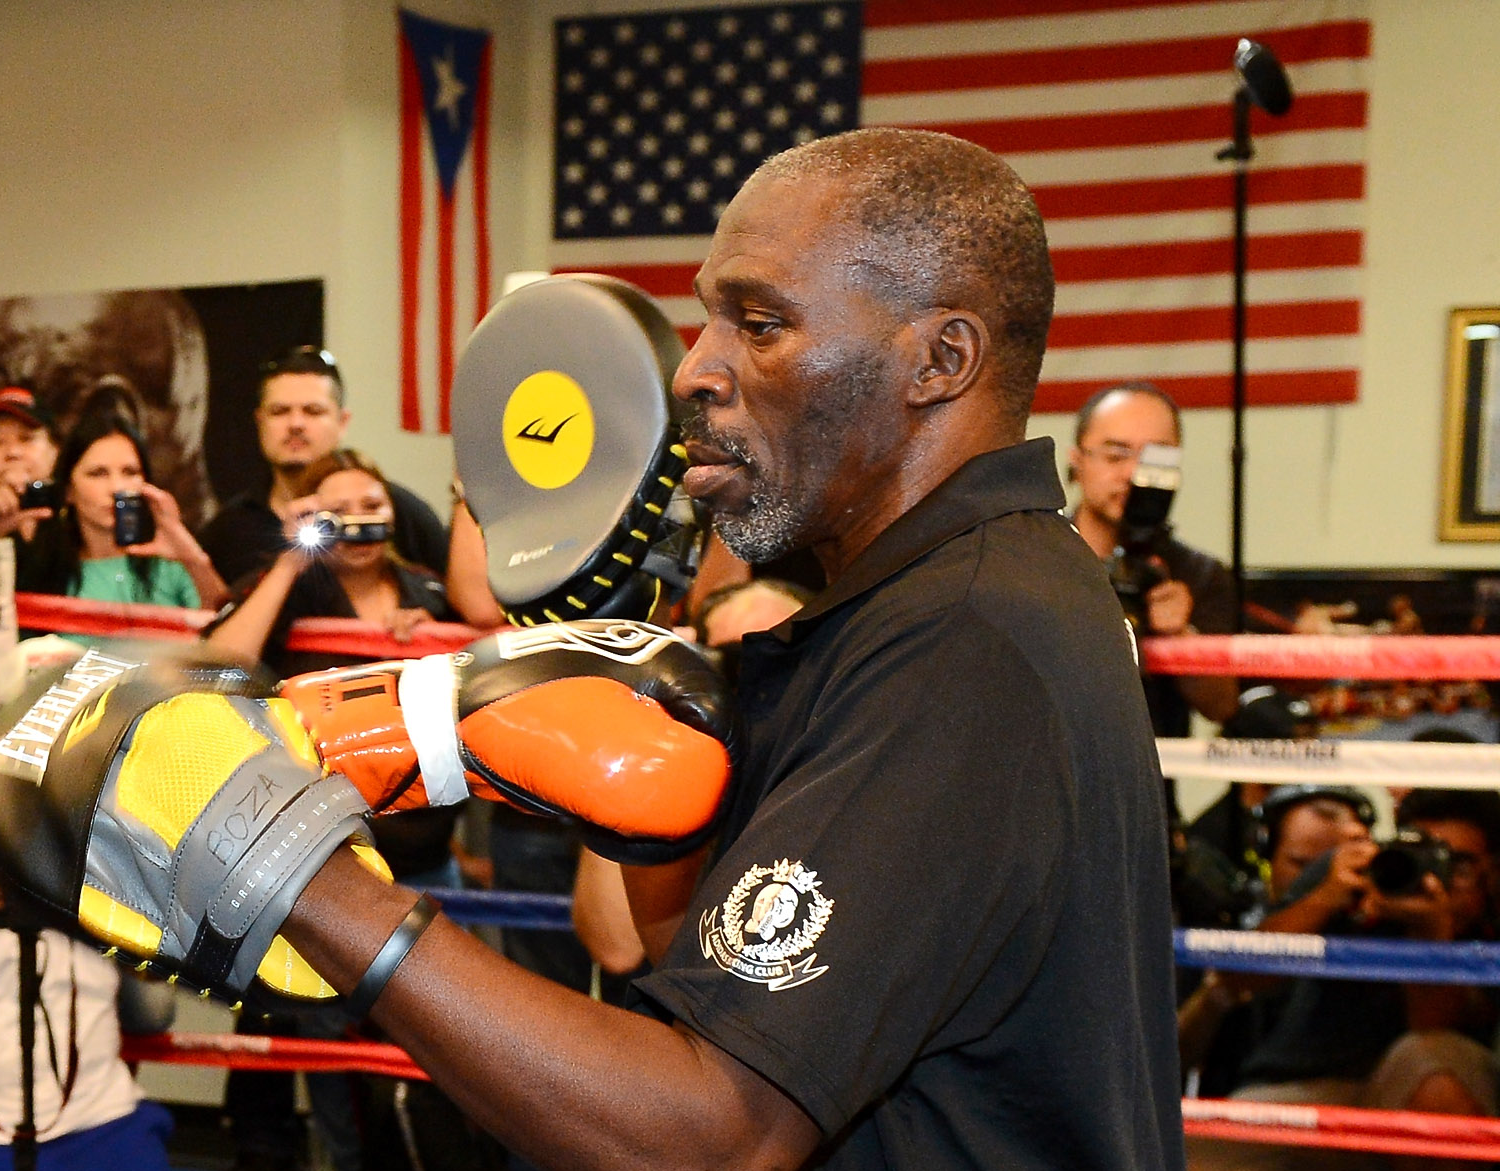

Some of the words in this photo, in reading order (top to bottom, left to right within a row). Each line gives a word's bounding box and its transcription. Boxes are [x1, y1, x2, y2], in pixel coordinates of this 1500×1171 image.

[206, 774, 283, 866] BOZA
[231, 820, 308, 909] GREATNESS
[312, 802, 329, 817] IS
[754, 965, 784, 978] CLUB
